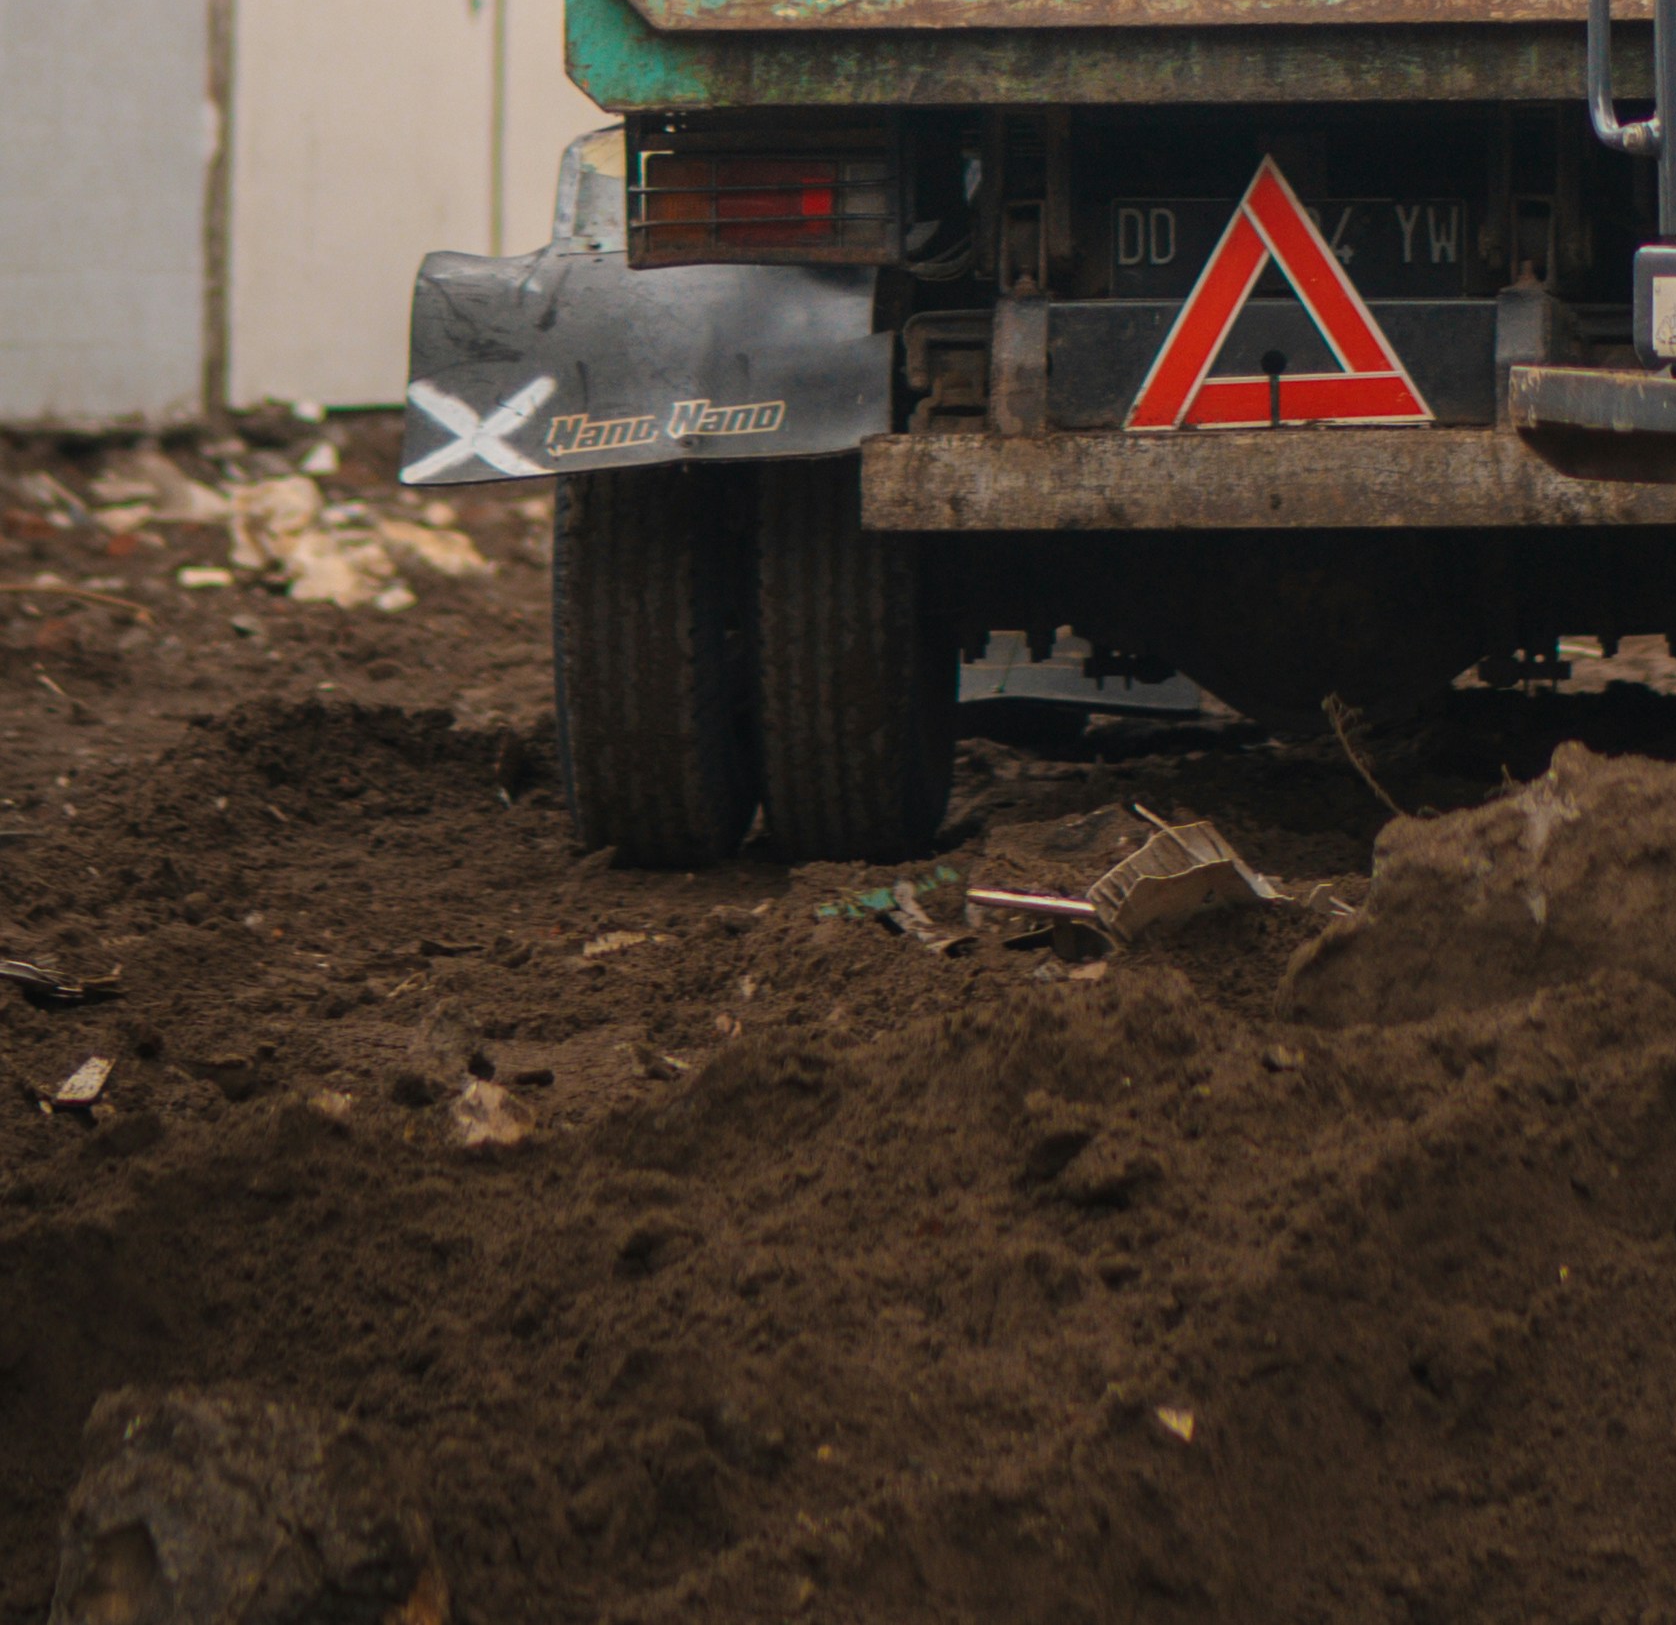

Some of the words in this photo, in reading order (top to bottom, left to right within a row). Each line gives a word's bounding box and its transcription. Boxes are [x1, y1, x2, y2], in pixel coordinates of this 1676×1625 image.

[1117, 207, 1176, 266] DD
[1394, 205, 1459, 264] YW
[666, 399, 785, 439] Nano
